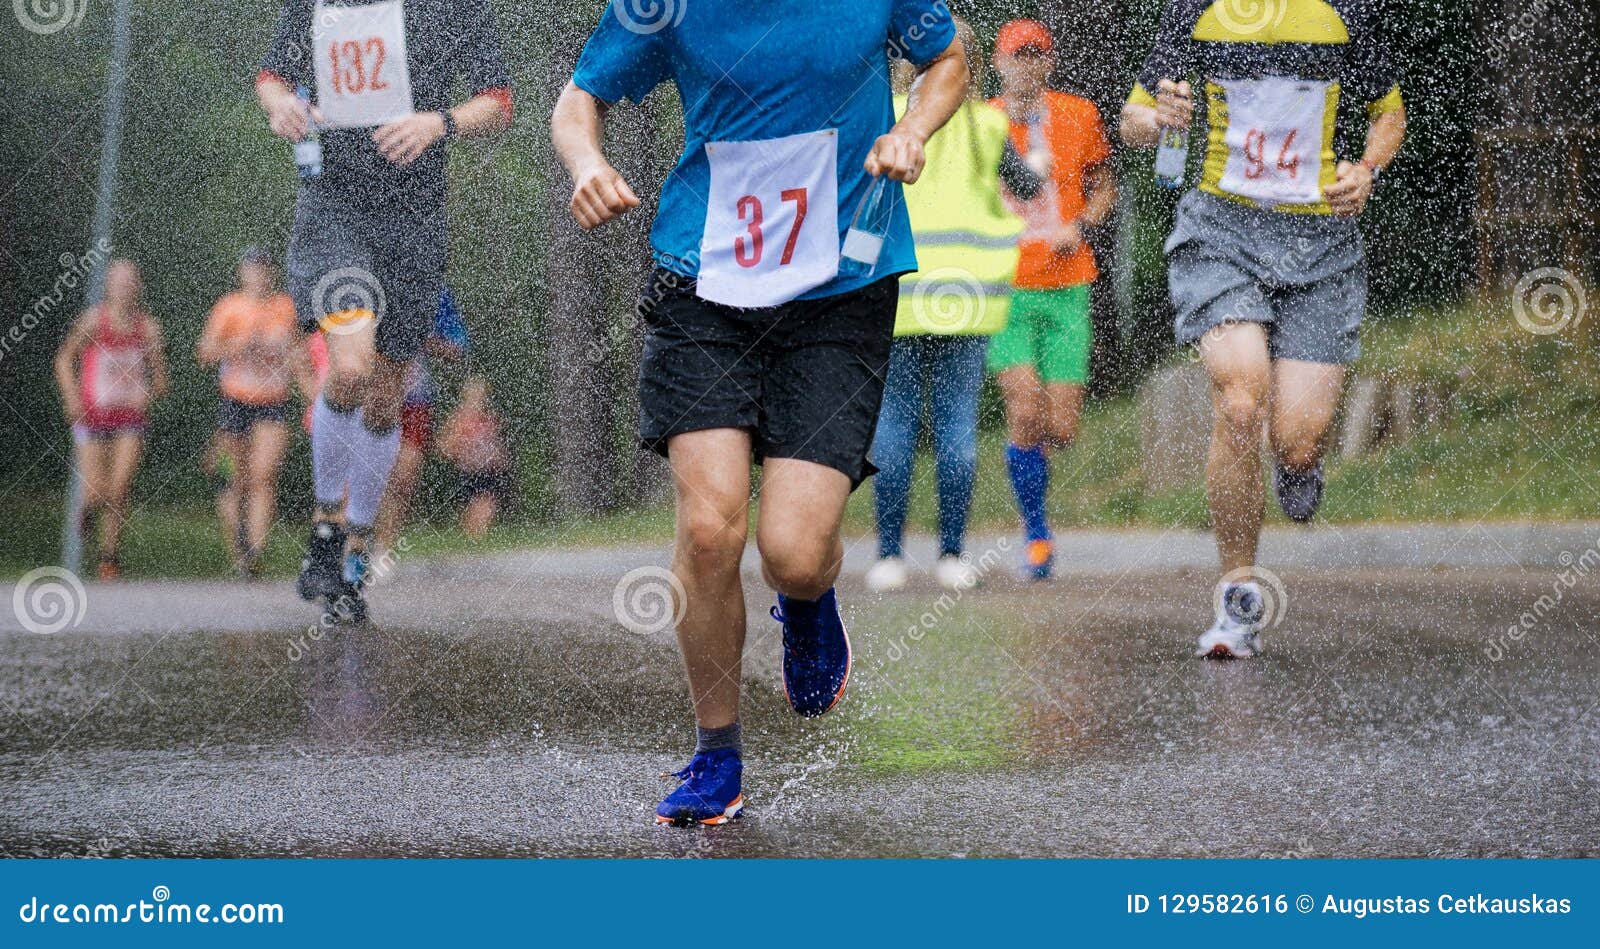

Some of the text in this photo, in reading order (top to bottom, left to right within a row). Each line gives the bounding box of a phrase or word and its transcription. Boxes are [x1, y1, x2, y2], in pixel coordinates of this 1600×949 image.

[328, 36, 391, 95] 132
[1244, 127, 1299, 180] 94
[734, 187, 808, 268] 37
